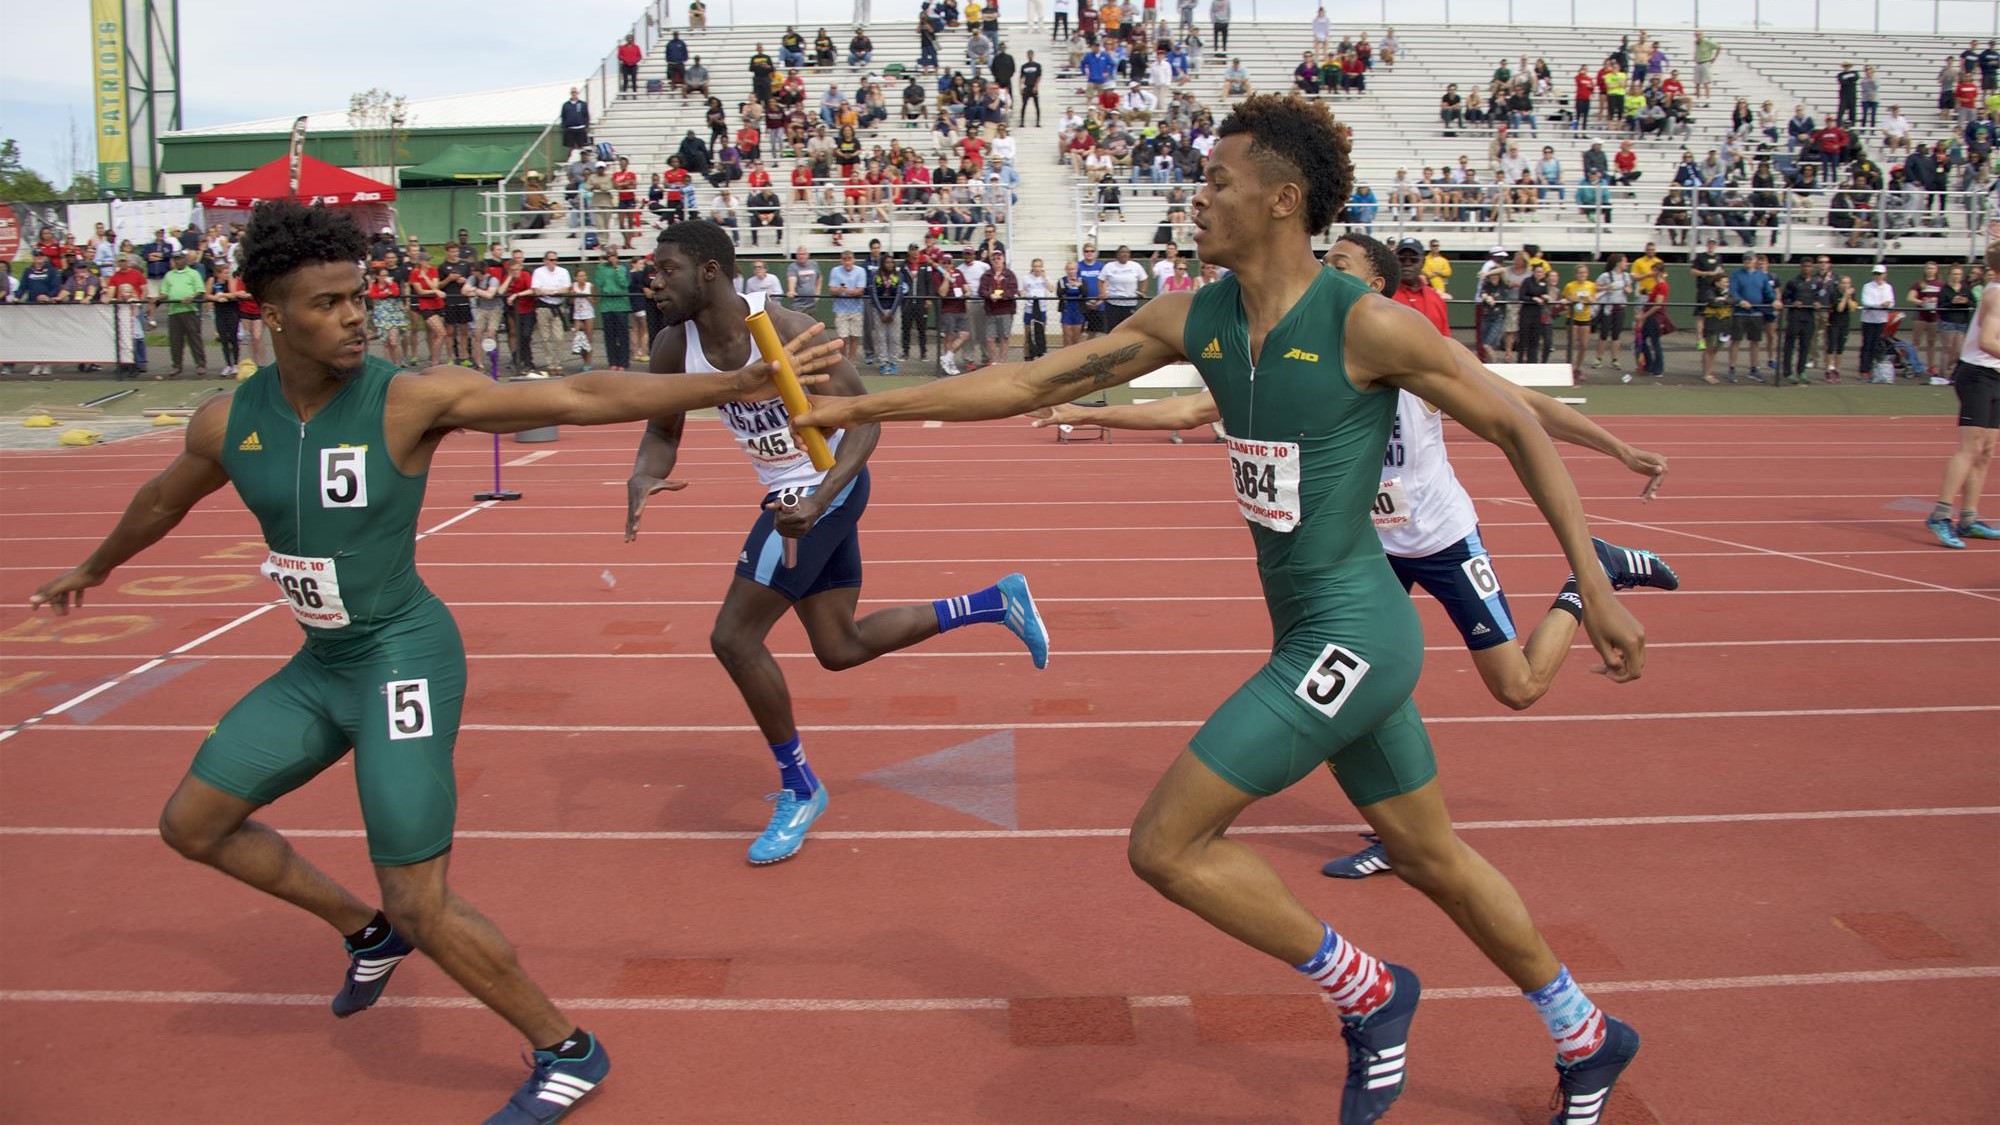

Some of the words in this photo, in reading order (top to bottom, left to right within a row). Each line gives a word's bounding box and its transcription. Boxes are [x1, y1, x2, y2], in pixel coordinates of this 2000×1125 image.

[99, 22, 121, 135] PATRIOTS
[1201, 351, 1223, 359] adidas
[1272, 446, 1288, 457] 10
[326, 452, 357, 503] 5
[1231, 457, 1277, 502] 364
[310, 562, 324, 571] 10
[1470, 558, 1495, 592] 6
[1307, 648, 1358, 705] 5
[395, 684, 424, 733] 5
